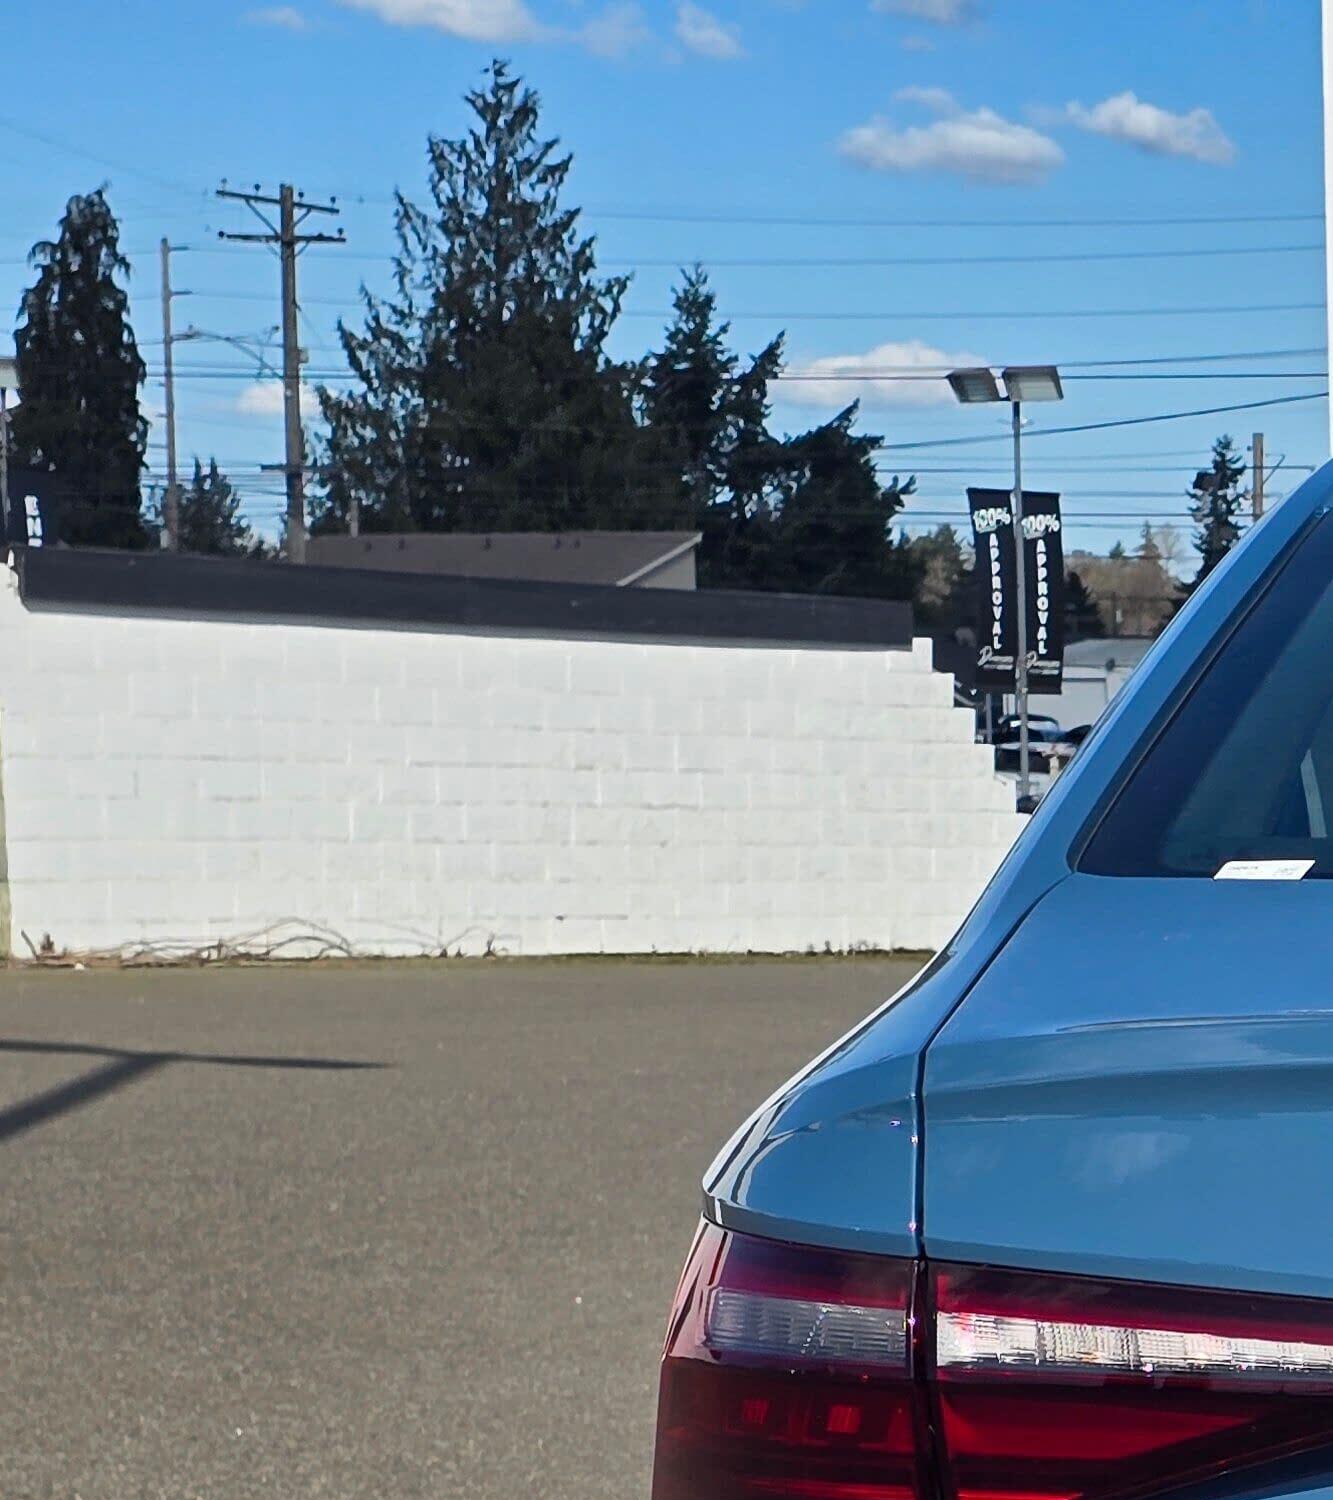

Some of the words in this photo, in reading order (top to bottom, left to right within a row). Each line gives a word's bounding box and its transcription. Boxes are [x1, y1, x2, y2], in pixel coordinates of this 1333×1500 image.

[973, 507, 1011, 534] 100%
[1021, 514, 1060, 540] 100%
[990, 533, 1002, 649] APPROVAL
[1037, 539, 1048, 654] APPROVAL
